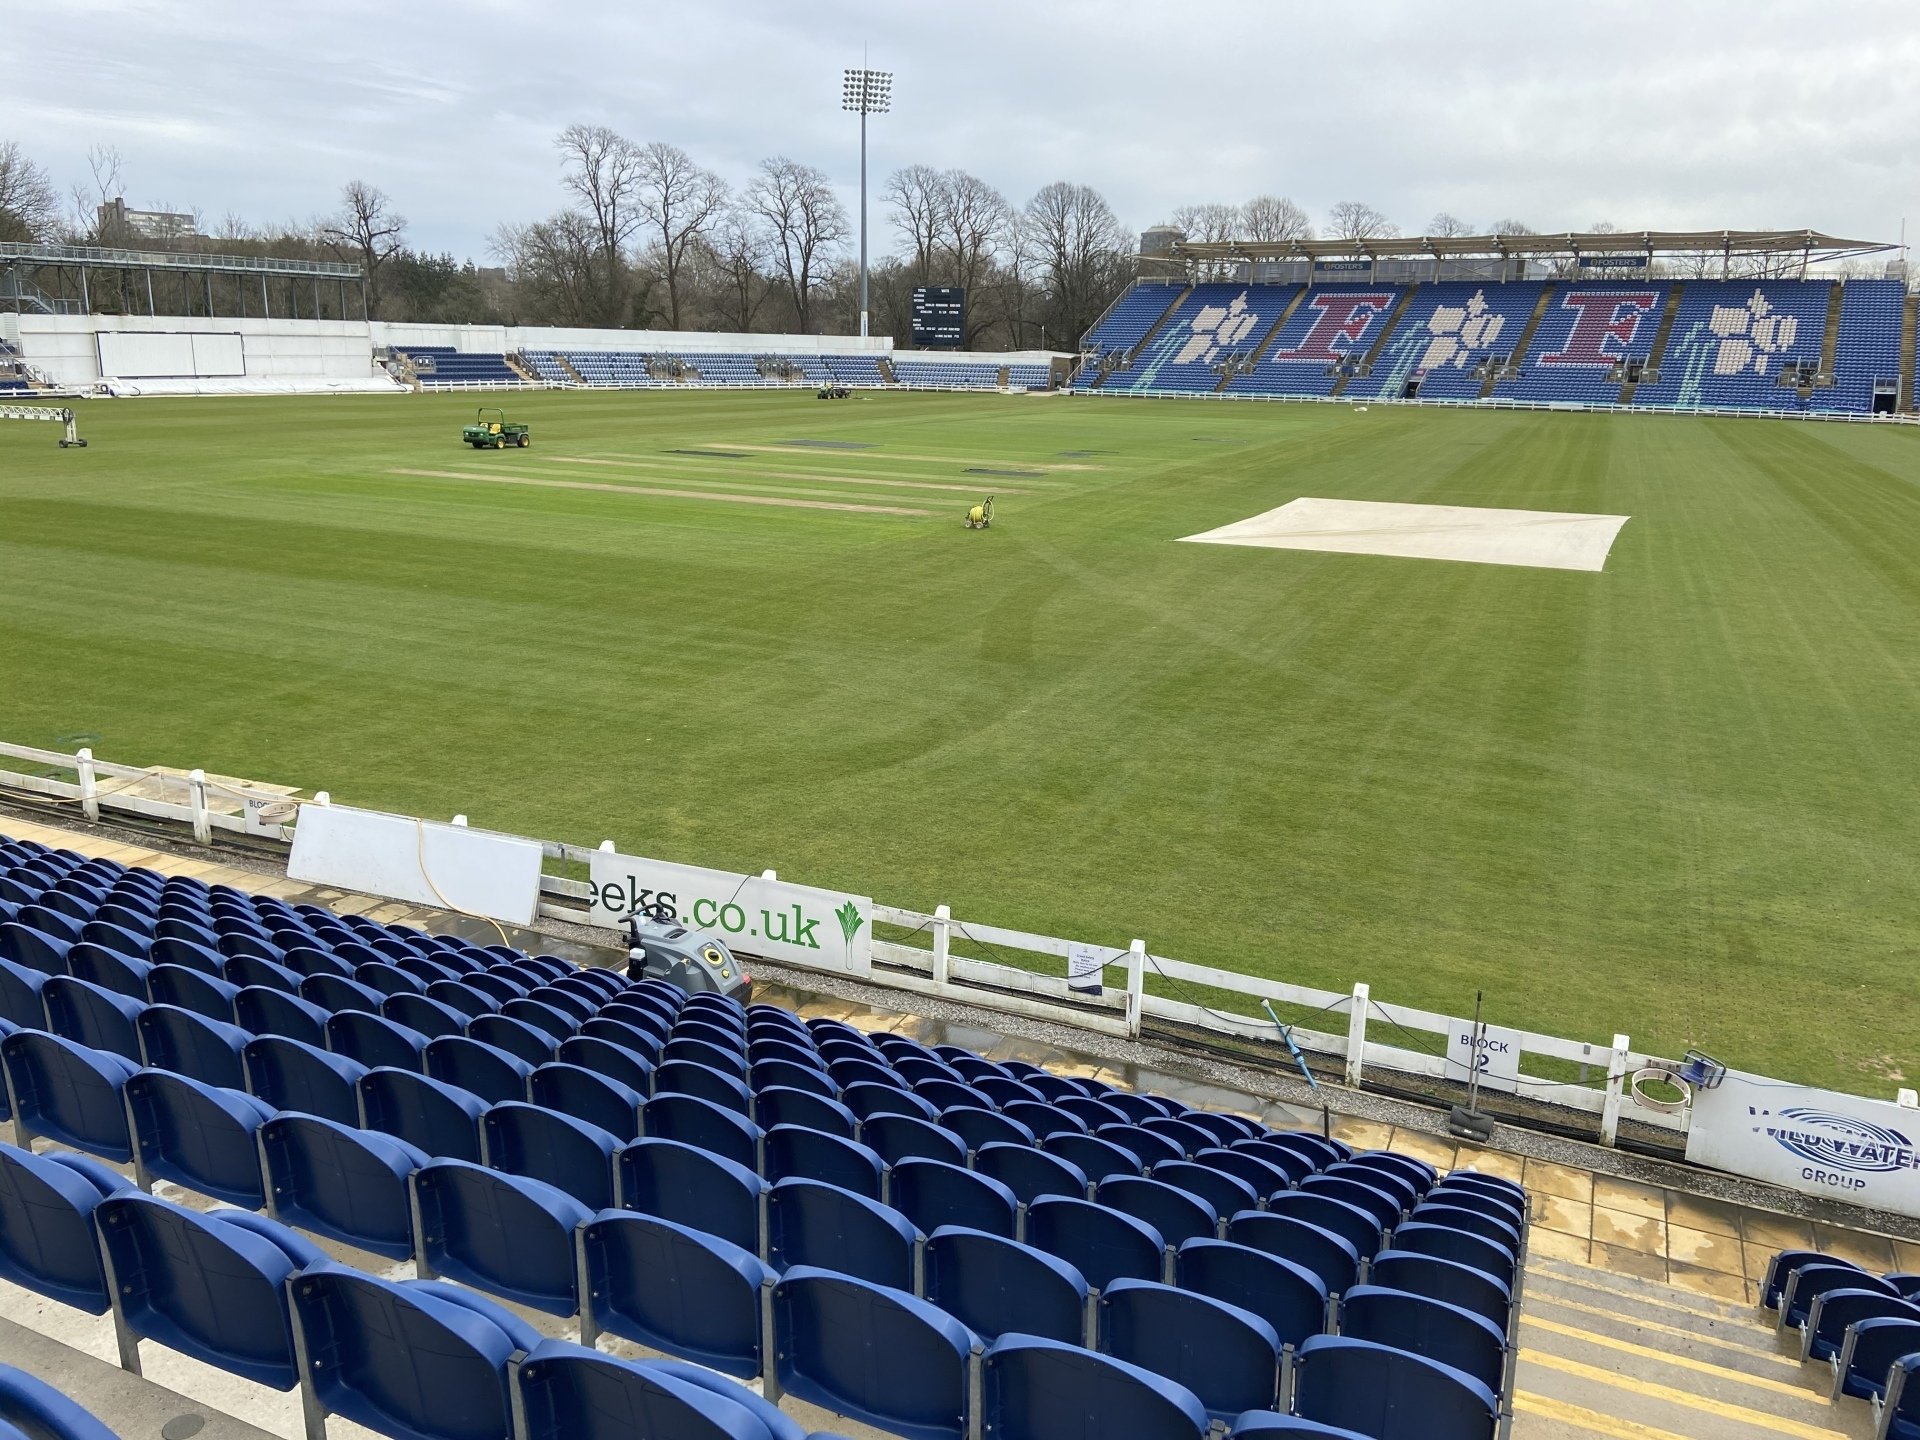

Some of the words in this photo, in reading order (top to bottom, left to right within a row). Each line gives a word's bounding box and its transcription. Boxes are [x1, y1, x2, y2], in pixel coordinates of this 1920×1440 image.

[1271, 293, 1395, 363] F
[1535, 292, 1660, 368] F
[248, 800, 273, 809] BLO
[1461, 1034, 1509, 1054] BLOCK
[1475, 1054, 1490, 1074] 2
[1802, 1167, 1866, 1192] GROUP
